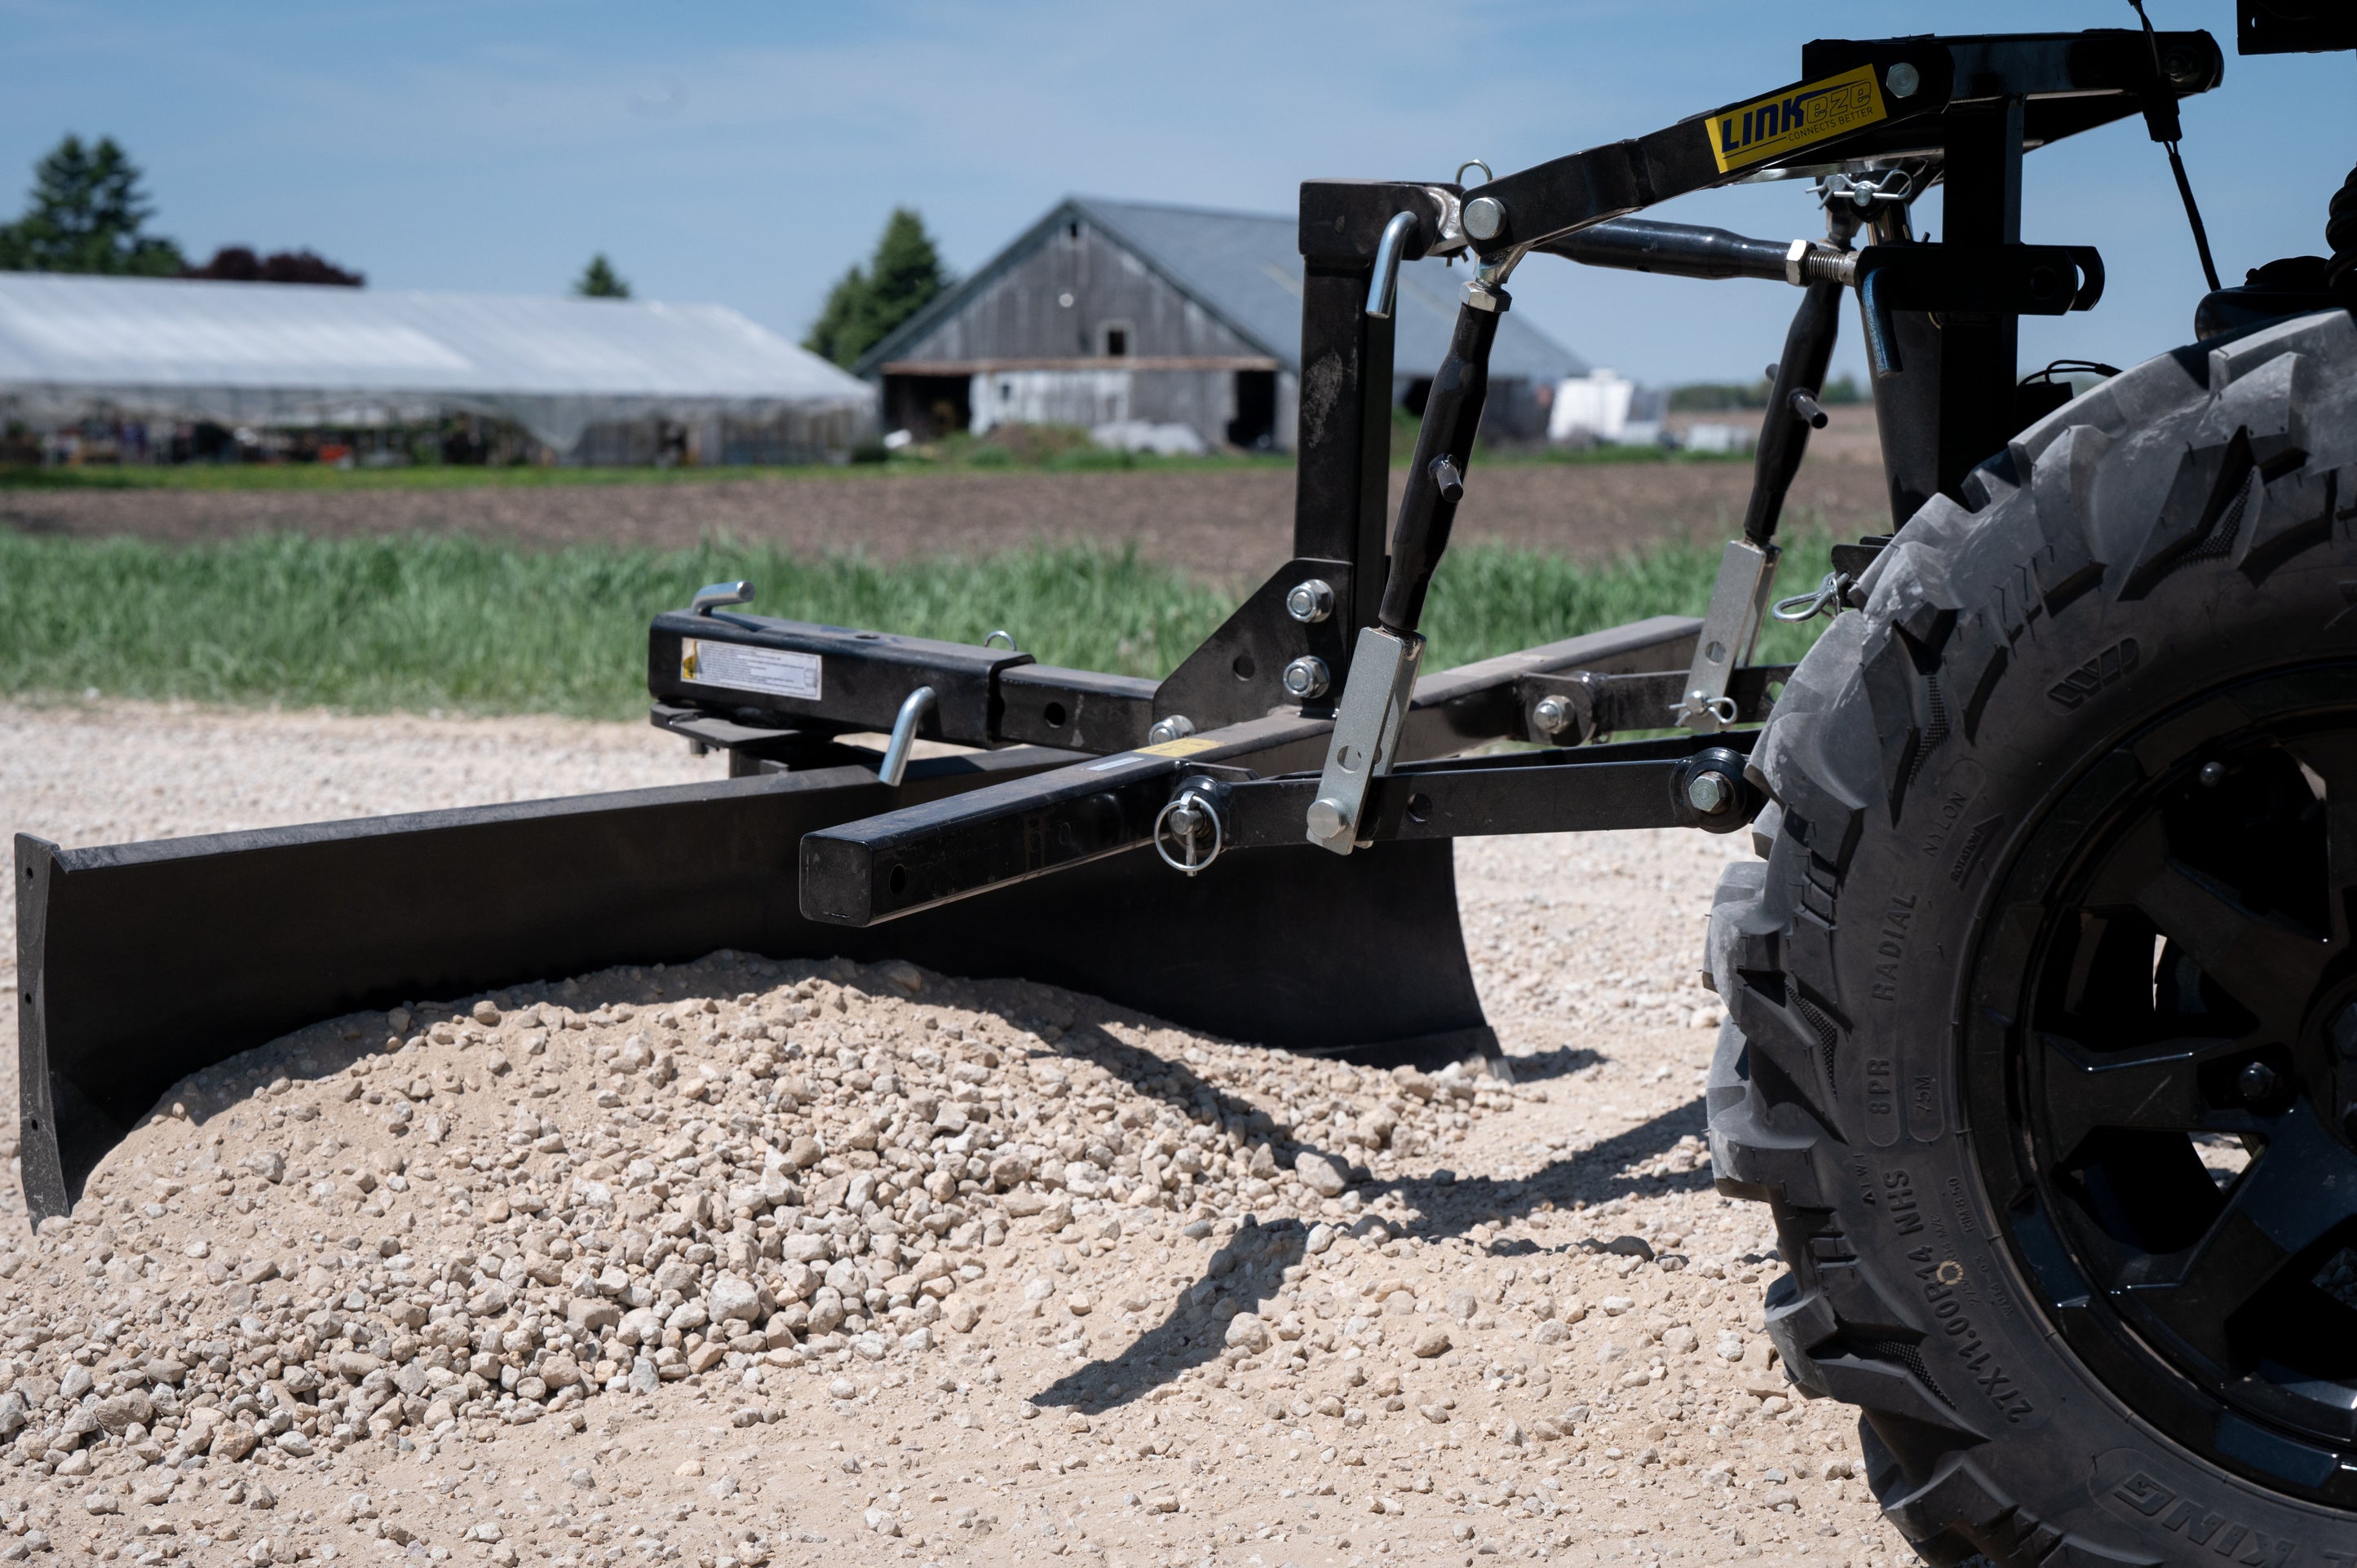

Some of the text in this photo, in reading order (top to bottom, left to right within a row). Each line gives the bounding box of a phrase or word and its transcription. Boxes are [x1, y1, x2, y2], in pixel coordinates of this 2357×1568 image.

[1789, 106, 1873, 142] CONNECTS BETTER
[1922, 791, 1966, 856] NYLON
[1873, 894, 1917, 1001] RADIAL
[1882, 1168, 1925, 1236] NHS
[2114, 1471, 2297, 1568] KING
